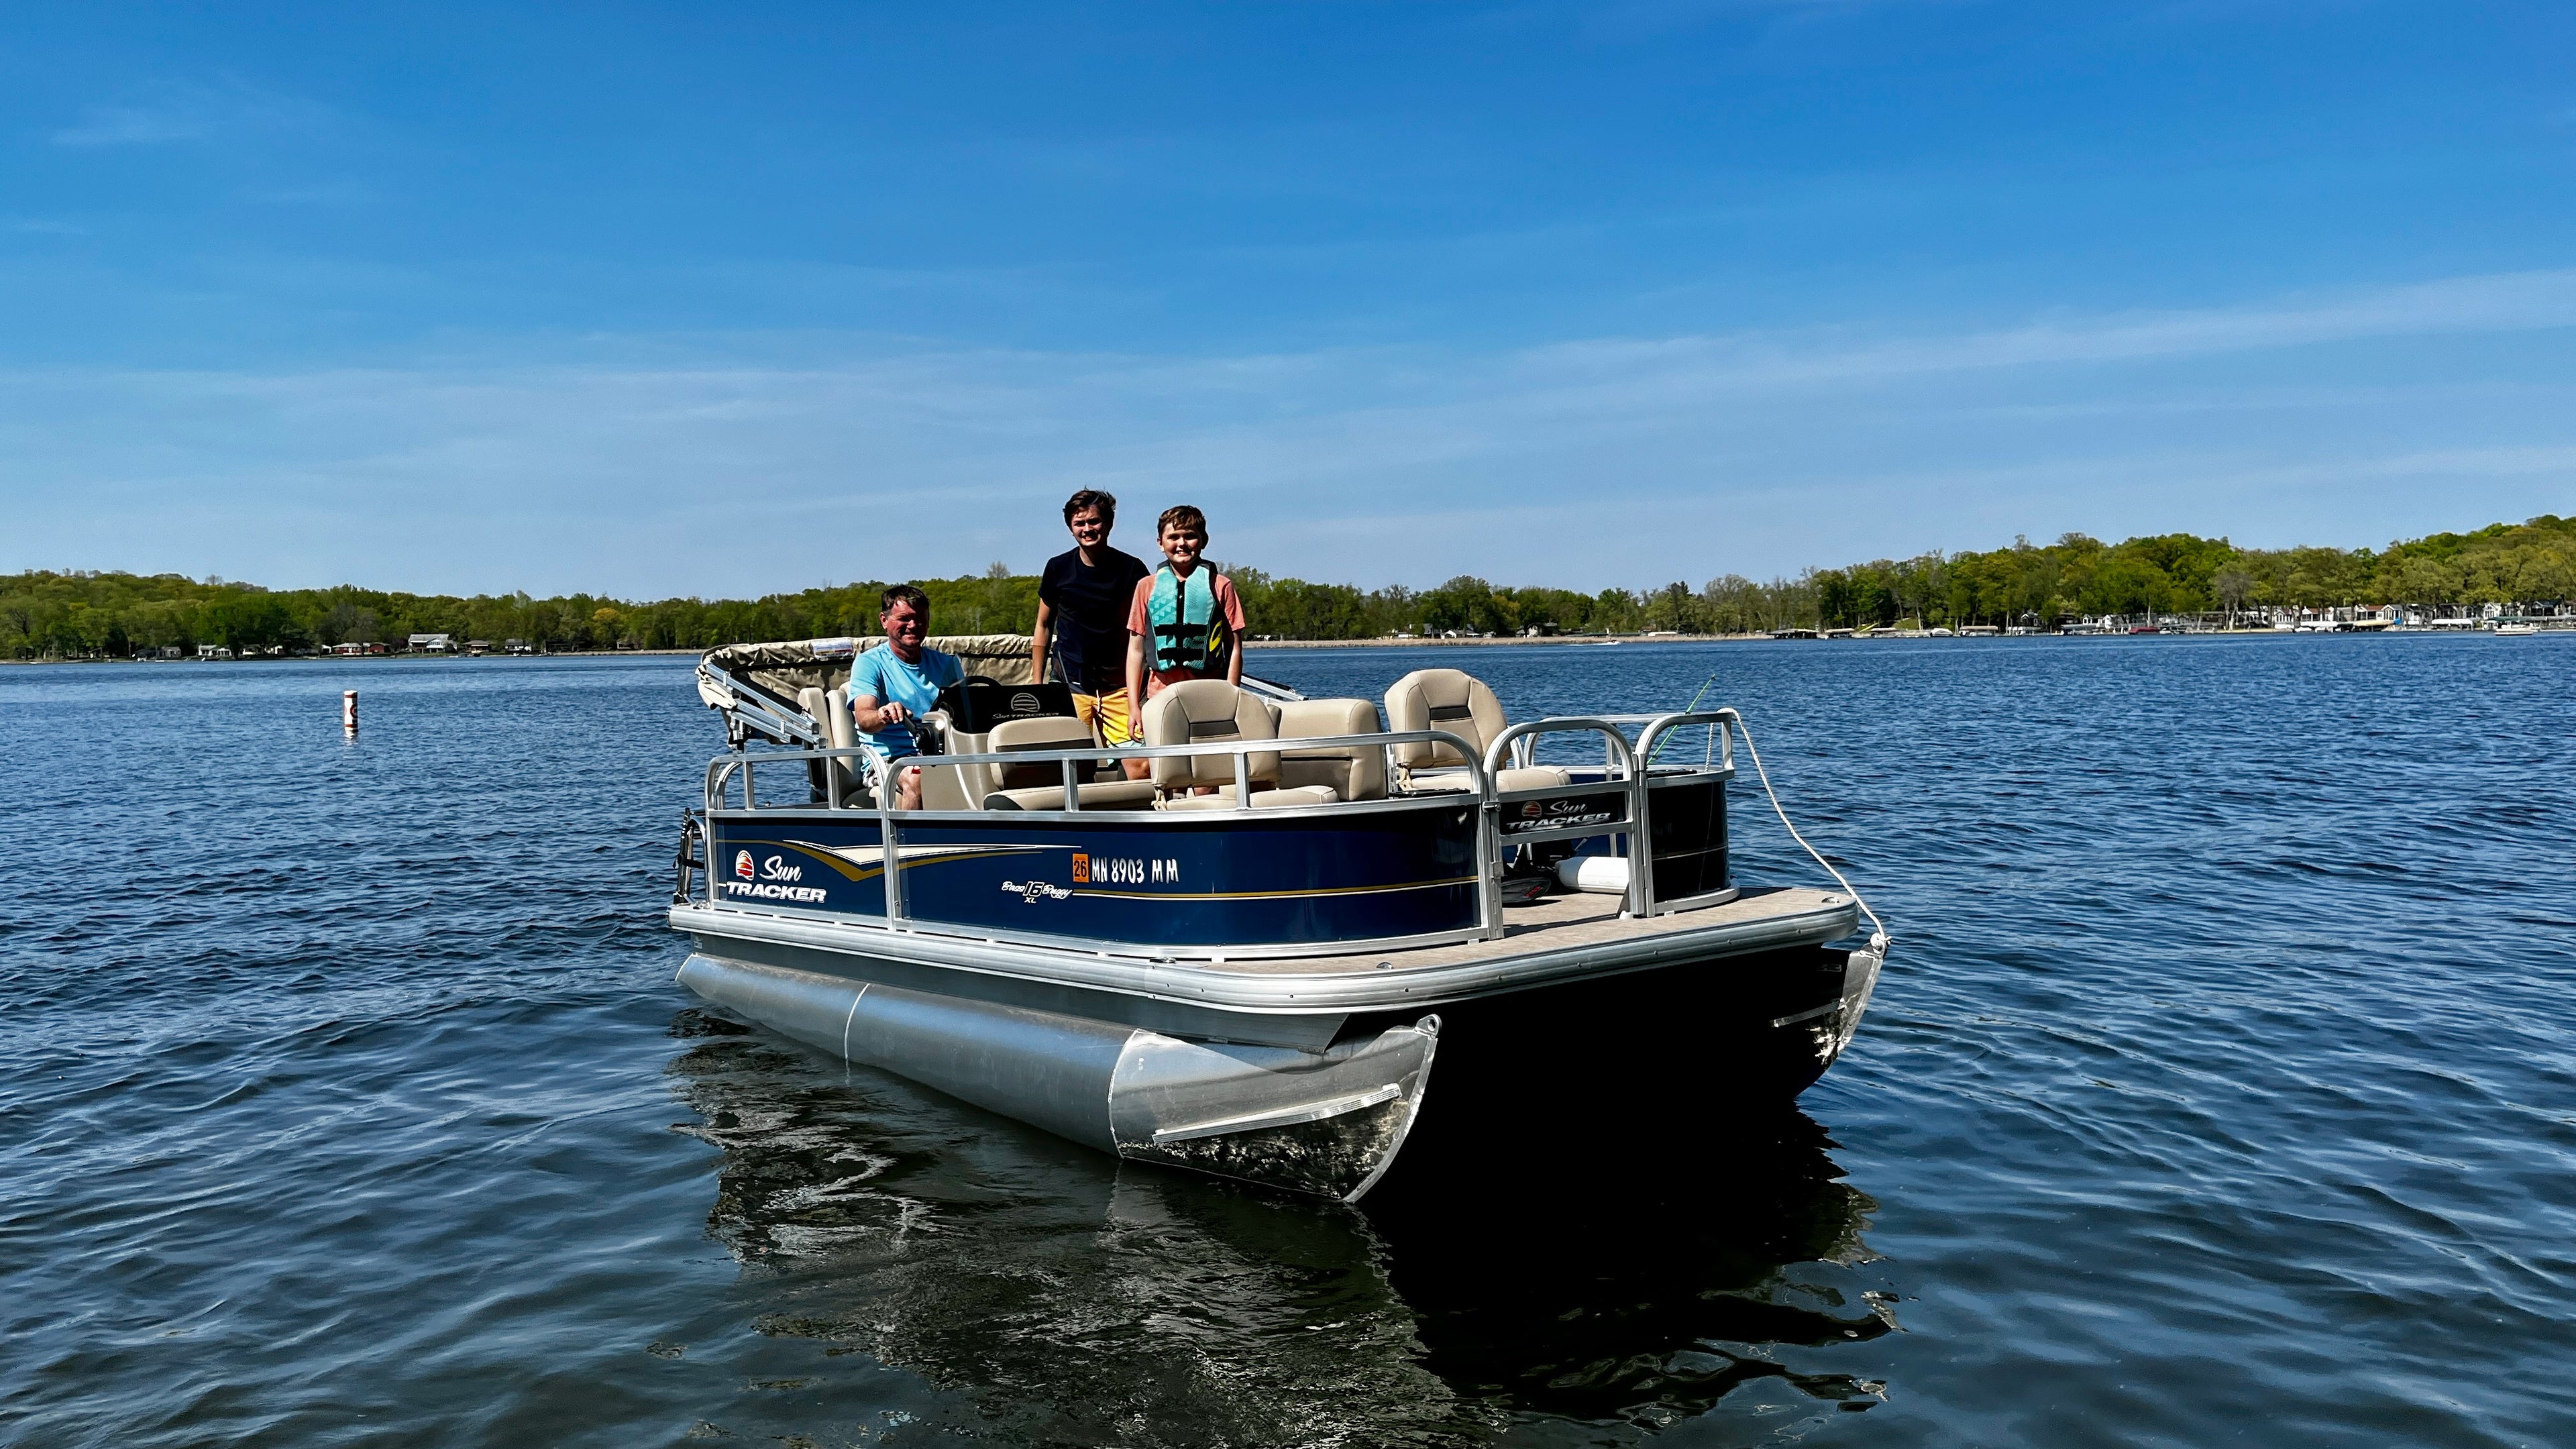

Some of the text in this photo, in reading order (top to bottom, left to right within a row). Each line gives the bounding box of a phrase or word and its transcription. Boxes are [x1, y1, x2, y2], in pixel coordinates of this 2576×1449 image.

[1544, 800, 1587, 815] Sun
[1507, 812, 1611, 830] TRACKER
[759, 855, 802, 882] Sun
[1073, 860, 1087, 877] 26
[1091, 857, 1108, 883] MN
[1111, 857, 1144, 883] 8903
[727, 881, 826, 904] TRACKER
[1022, 881, 1044, 897] 16
[1042, 884, 1073, 900] Buggy
